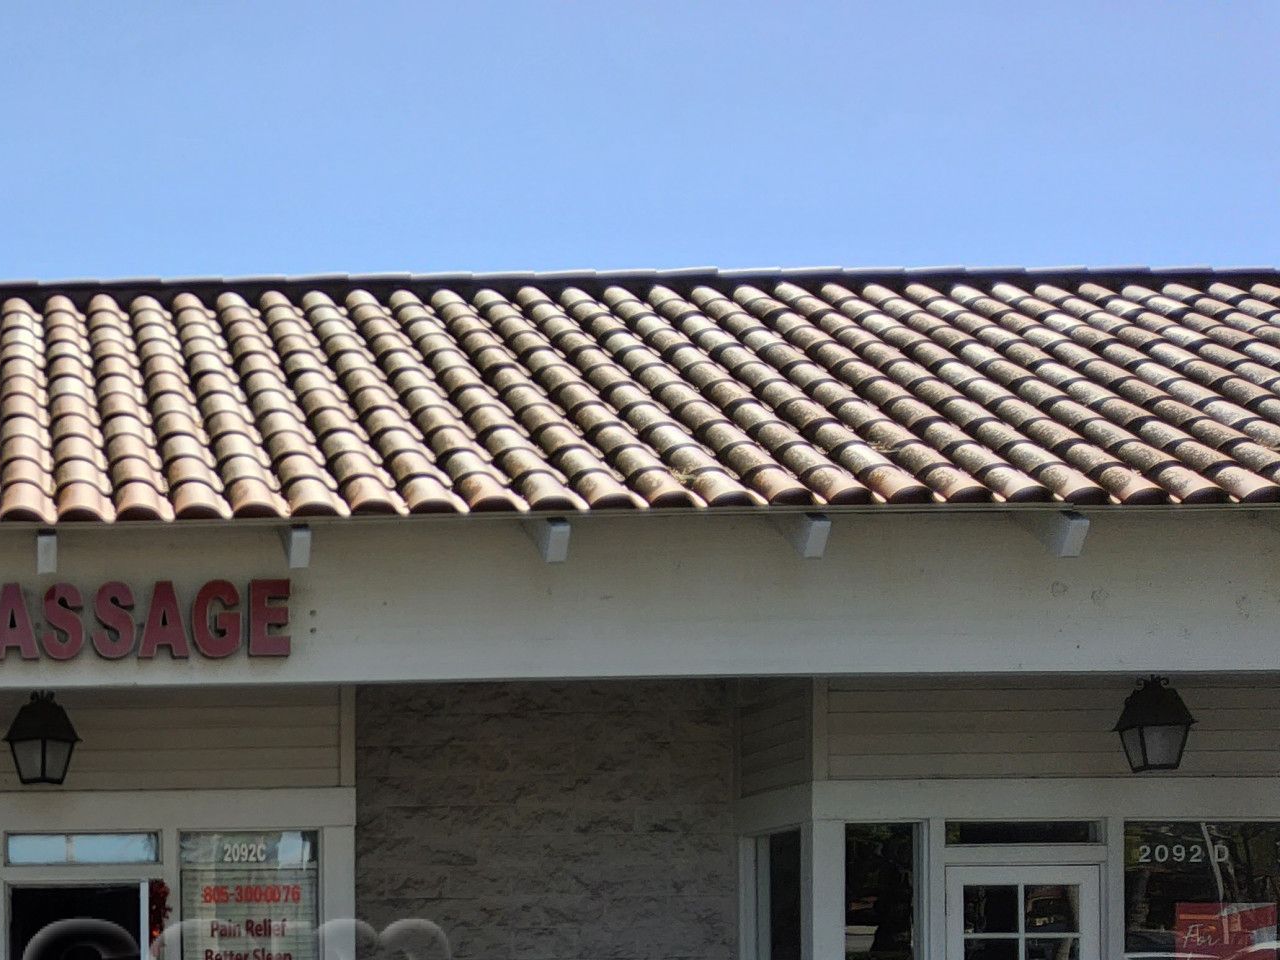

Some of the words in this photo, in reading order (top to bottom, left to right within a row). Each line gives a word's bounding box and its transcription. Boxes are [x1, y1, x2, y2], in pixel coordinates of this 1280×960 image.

[223, 843, 266, 862] 2092C
[1138, 845, 1202, 863] 2092
[1215, 845, 1230, 863] D
[210, 919, 241, 937] Pain
[245, 919, 287, 938] Relief
